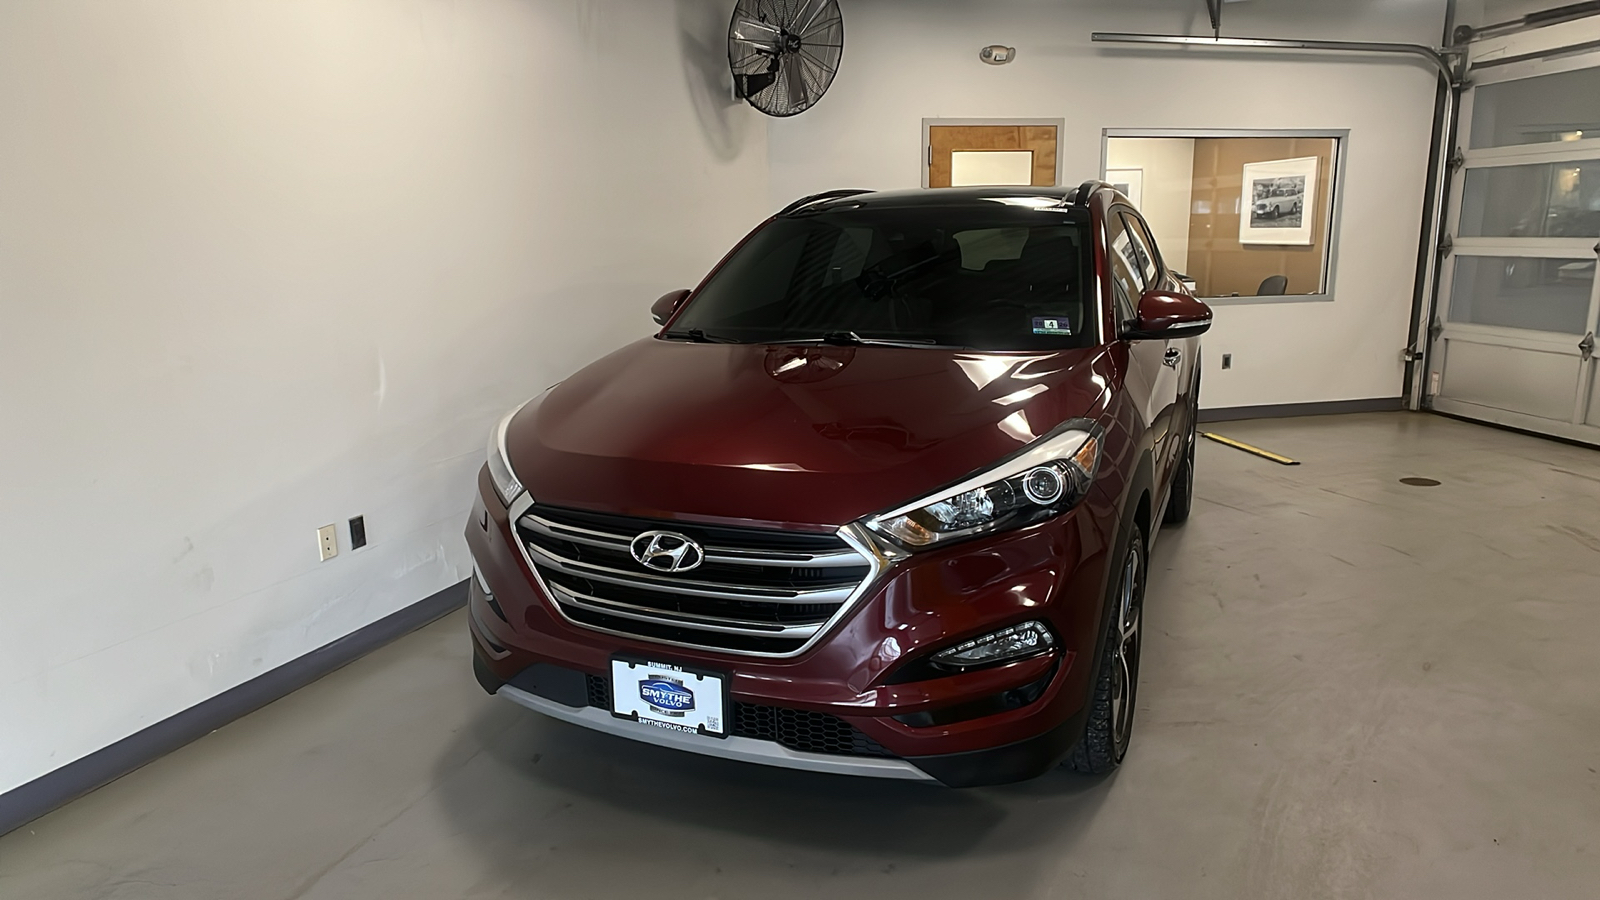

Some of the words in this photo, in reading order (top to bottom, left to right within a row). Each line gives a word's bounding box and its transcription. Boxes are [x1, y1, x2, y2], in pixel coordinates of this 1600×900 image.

[674, 665, 683, 673] NJ
[641, 688, 691, 704] SMYTHE
[653, 696, 683, 708] VOLVO
[638, 717, 698, 735] SMYTHEVOLVO.COM
